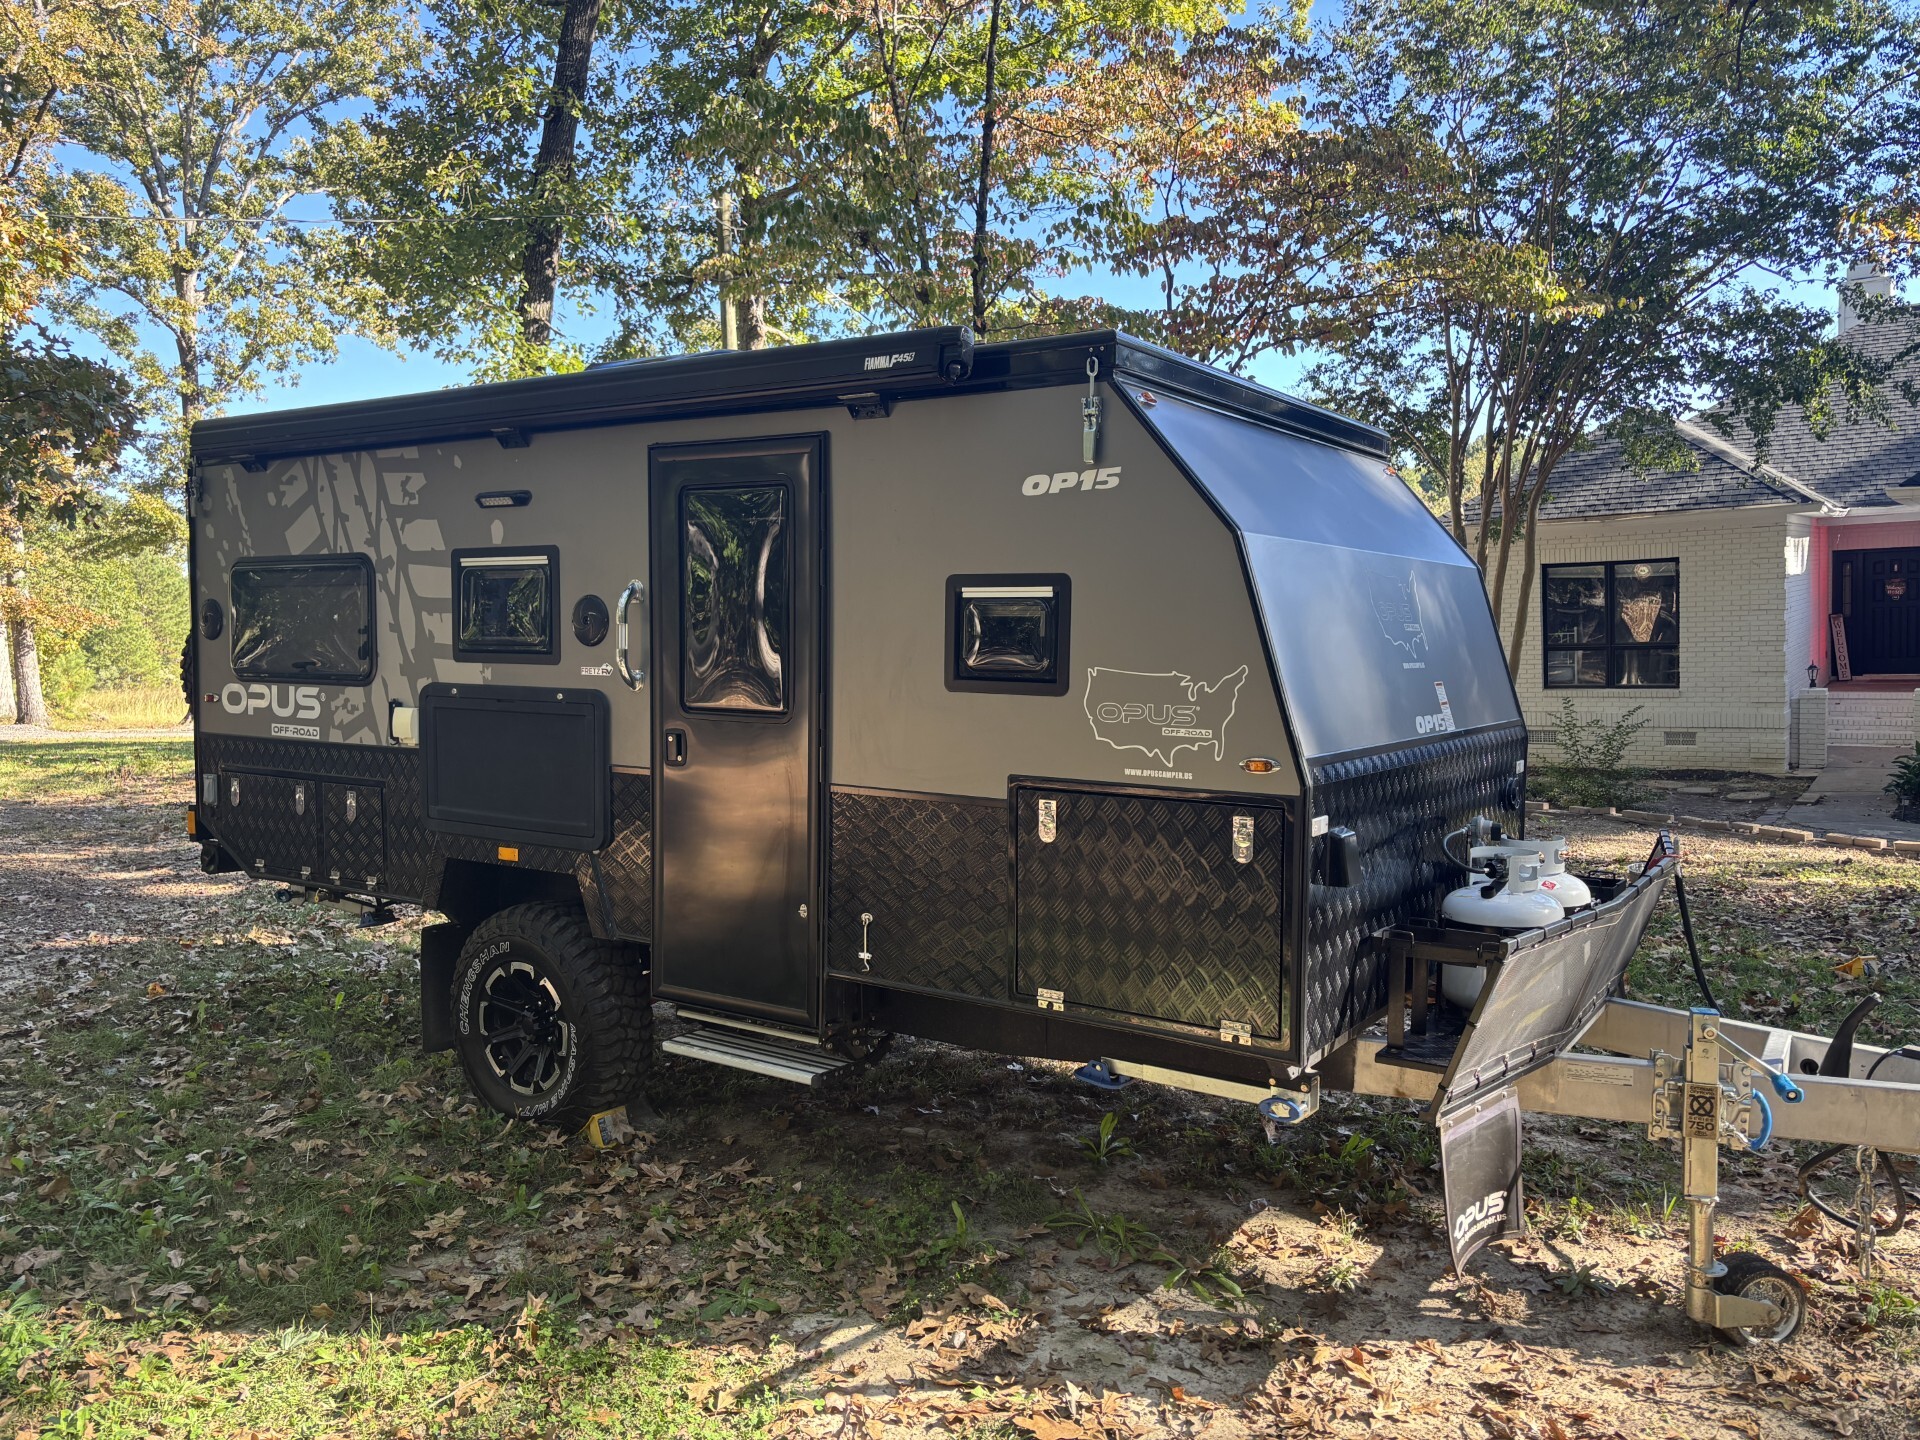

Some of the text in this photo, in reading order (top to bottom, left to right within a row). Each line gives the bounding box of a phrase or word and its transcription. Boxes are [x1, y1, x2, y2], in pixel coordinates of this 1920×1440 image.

[864, 355, 890, 370] FIAMMA
[1022, 466, 1122, 496] OP15
[1833, 620, 1848, 679] WELCOME
[581, 667, 600, 675] FRETZ
[222, 683, 320, 720] OPUS
[1097, 702, 1197, 726] OPUS
[1416, 714, 1446, 734] OP15
[272, 726, 318, 737] OFF-ROAD
[1163, 729, 1211, 737] OFF-ROAD
[1124, 768, 1193, 780] WWW.OPUSCAMPER.US
[459, 942, 510, 1035] CHENGSHAN
[1688, 1120, 1715, 1131] 750
[1454, 1190, 1504, 1240] OPUS
